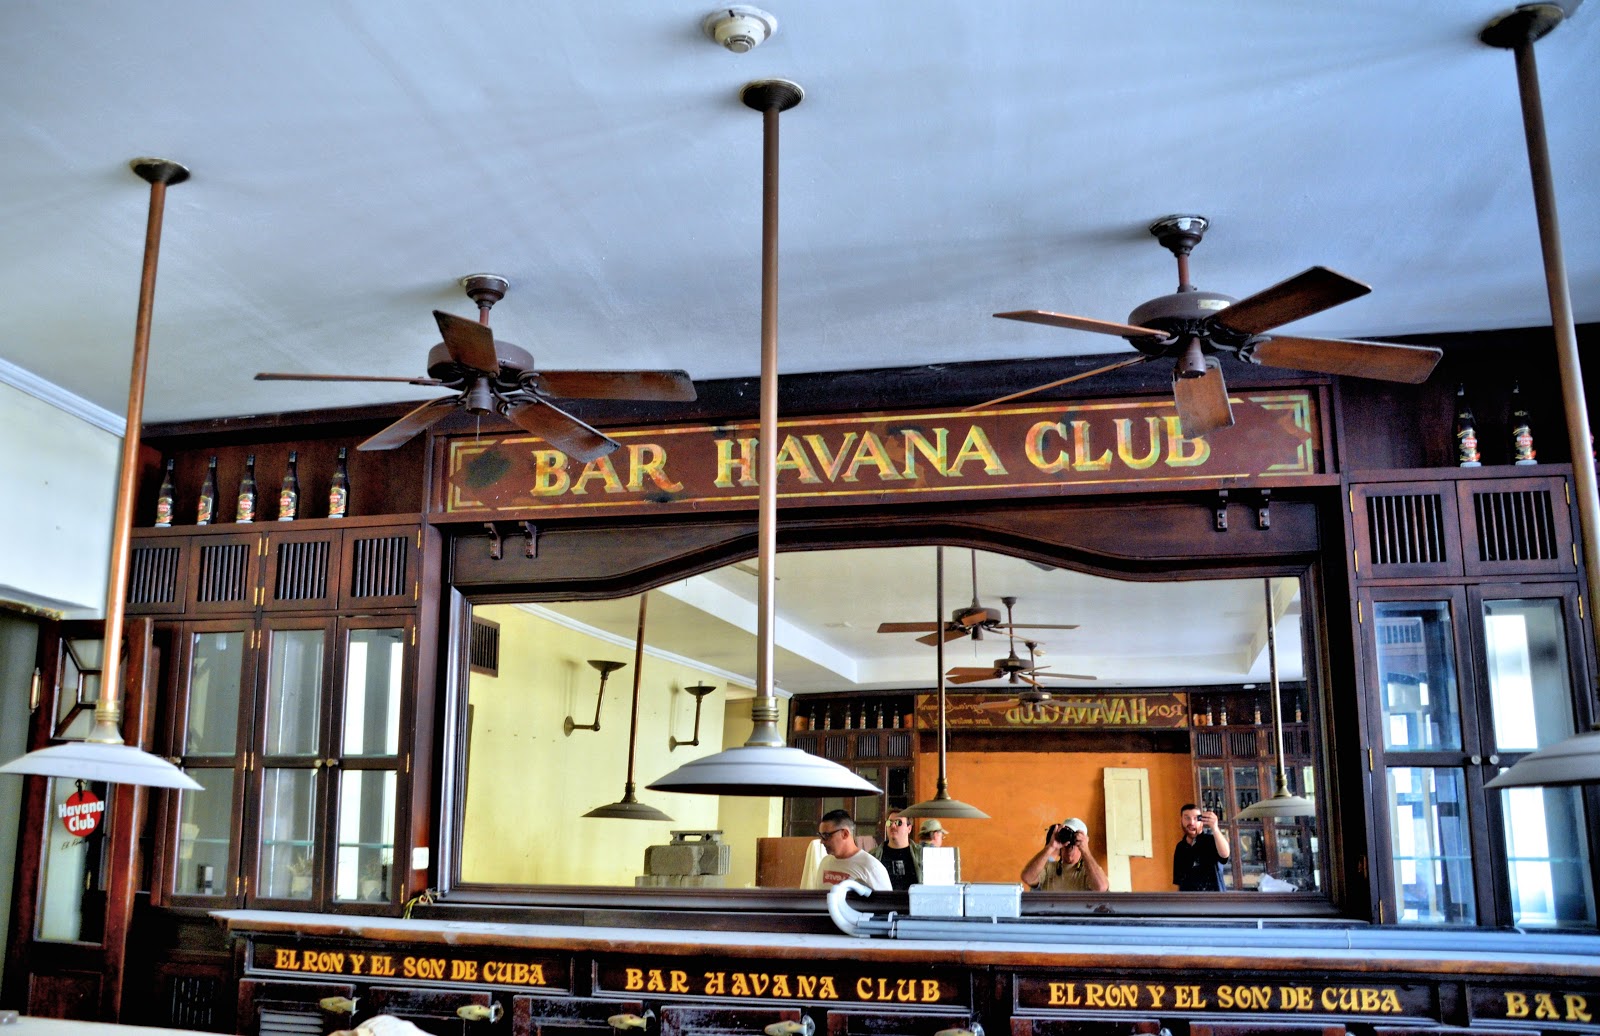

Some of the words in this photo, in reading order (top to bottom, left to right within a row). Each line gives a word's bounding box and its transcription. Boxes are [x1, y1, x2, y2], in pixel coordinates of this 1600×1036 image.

[530, 443, 684, 497] BAR
[713, 424, 1009, 489] HAVANA
[1024, 414, 1211, 474] CLUB
[58, 800, 105, 819] Havana
[68, 813, 95, 831] Club
[275, 949, 300, 970] EL
[302, 950, 344, 973] RON
[351, 953, 365, 974] Y
[369, 955, 395, 977] EL
[403, 956, 447, 980] SON
[451, 959, 478, 982] DE
[482, 961, 546, 985] CUBA
[625, 967, 690, 993] BAR
[704, 971, 839, 999] HAVANA
[856, 977, 941, 1002] CLUB
[1048, 982, 1081, 1006] EL
[1084, 983, 1139, 1008] RON
[1146, 985, 1166, 1008] Y
[1174, 985, 1206, 1009] EL
[1217, 985, 1271, 1010] SON
[1279, 986, 1314, 1011] DE
[1321, 987, 1403, 1013] CUBA
[1504, 991, 1592, 1023] BAR
